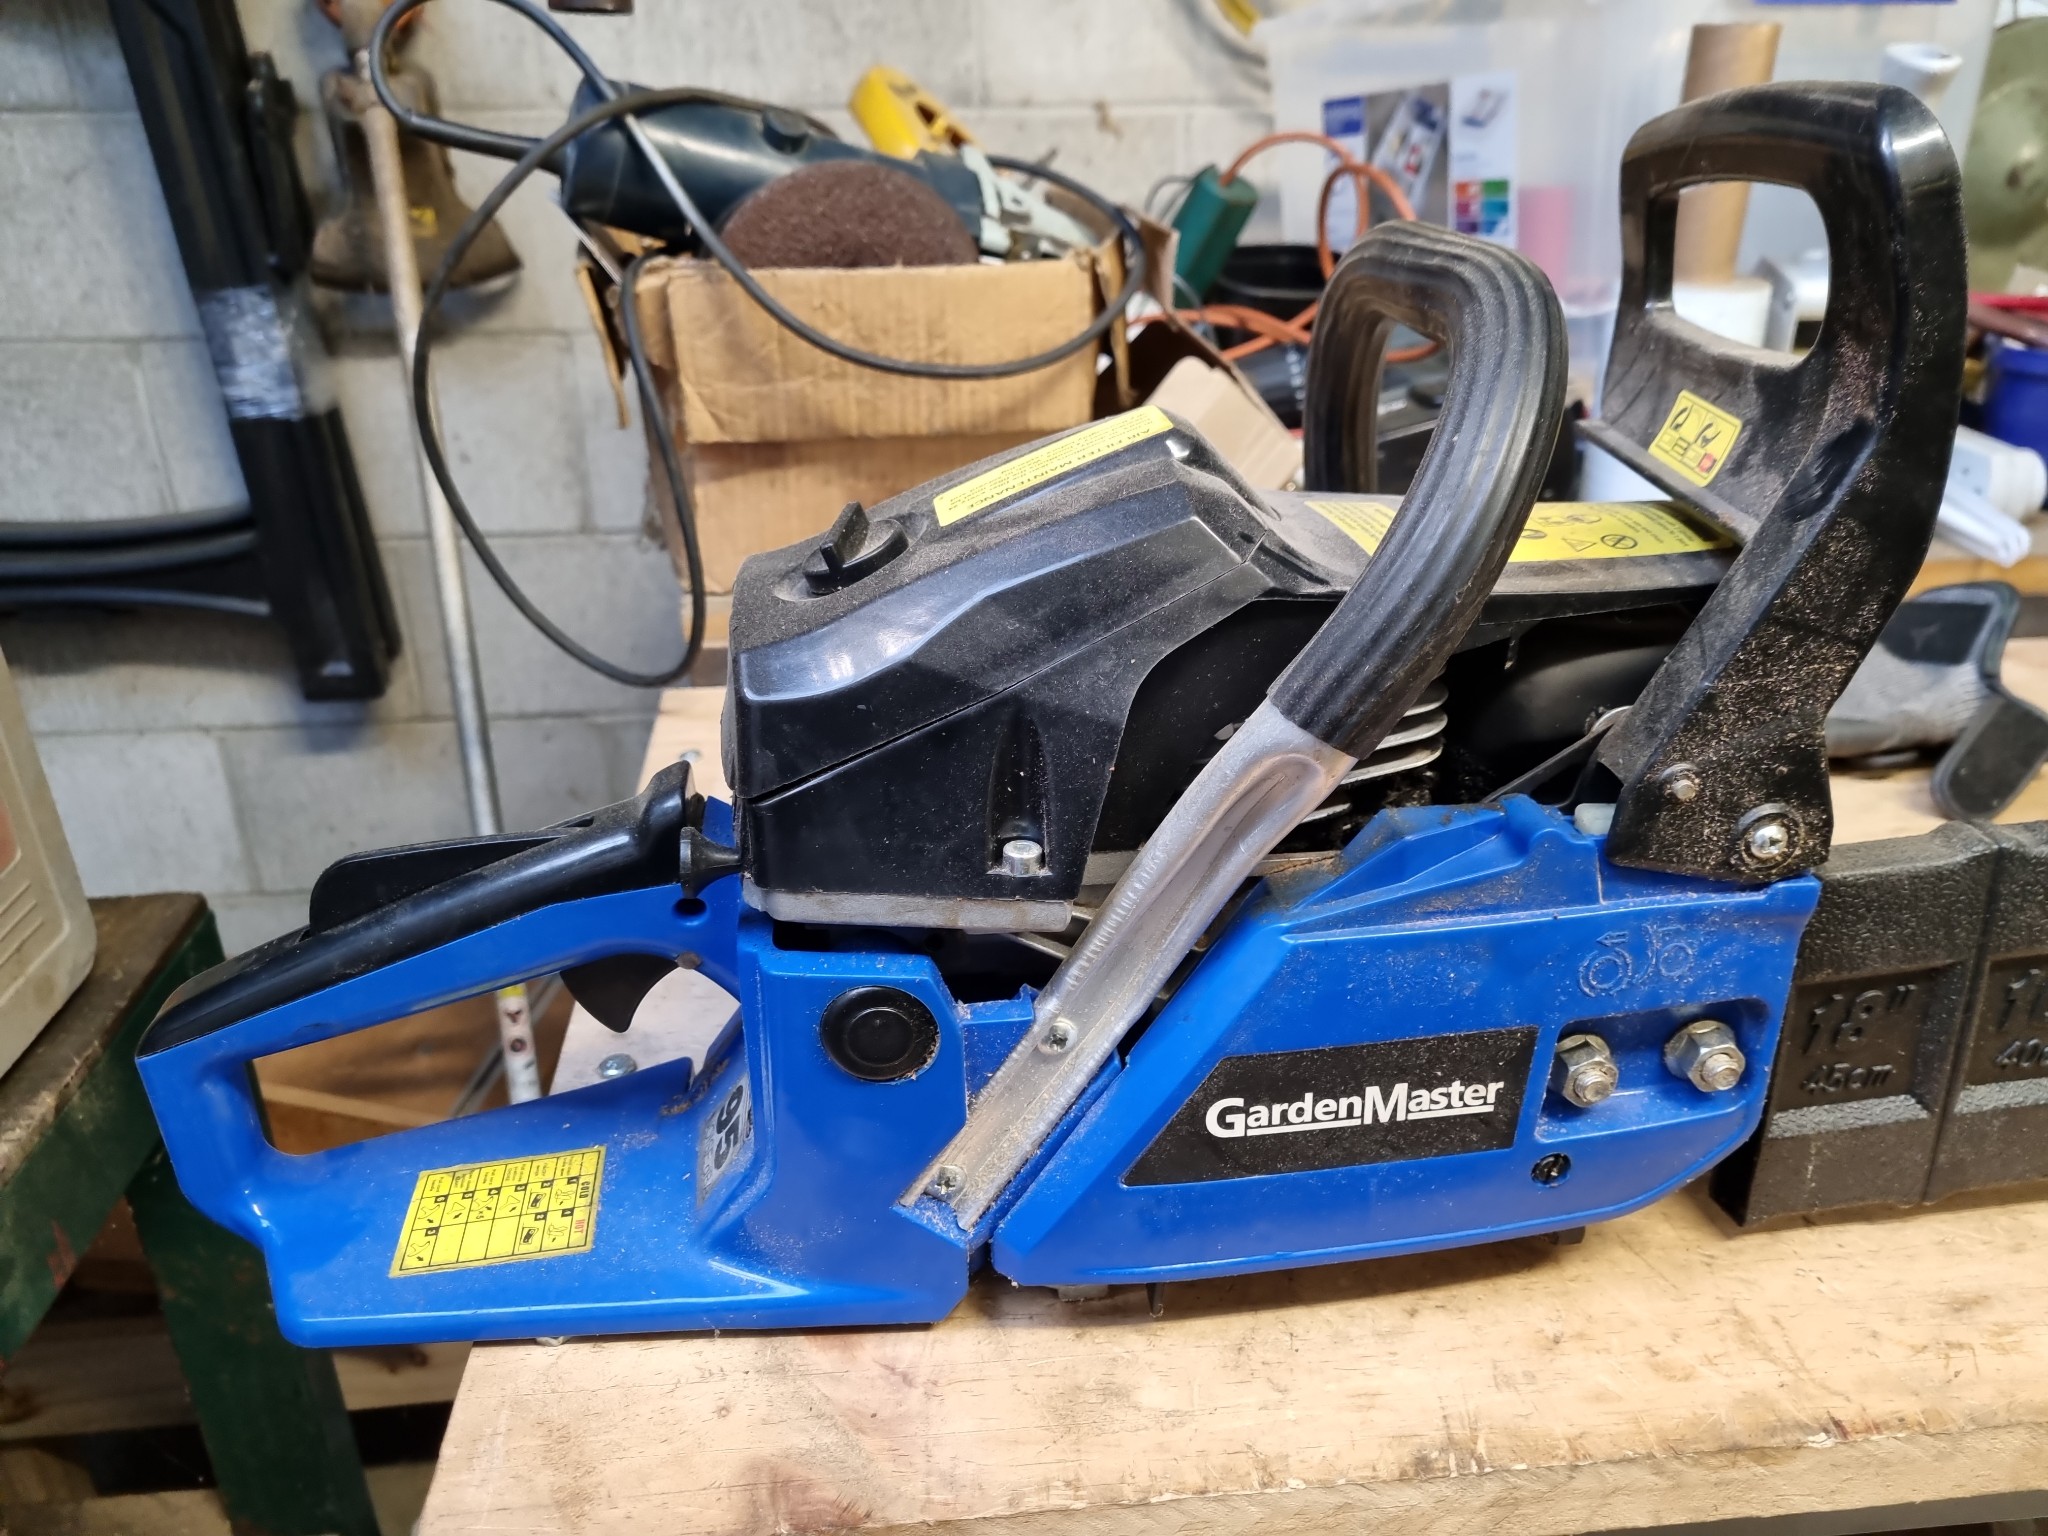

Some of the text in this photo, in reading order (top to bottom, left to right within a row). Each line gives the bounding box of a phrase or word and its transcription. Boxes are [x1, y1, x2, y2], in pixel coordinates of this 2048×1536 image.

[968, 459, 1073, 508] MAINTENANCE
[1802, 1063, 1896, 1094] 45cm
[714, 1085, 743, 1170] 95
[1205, 1082, 1504, 1138] GardenMaster
[578, 1180, 591, 1199] COLD
[572, 1218, 586, 1235] HOT
